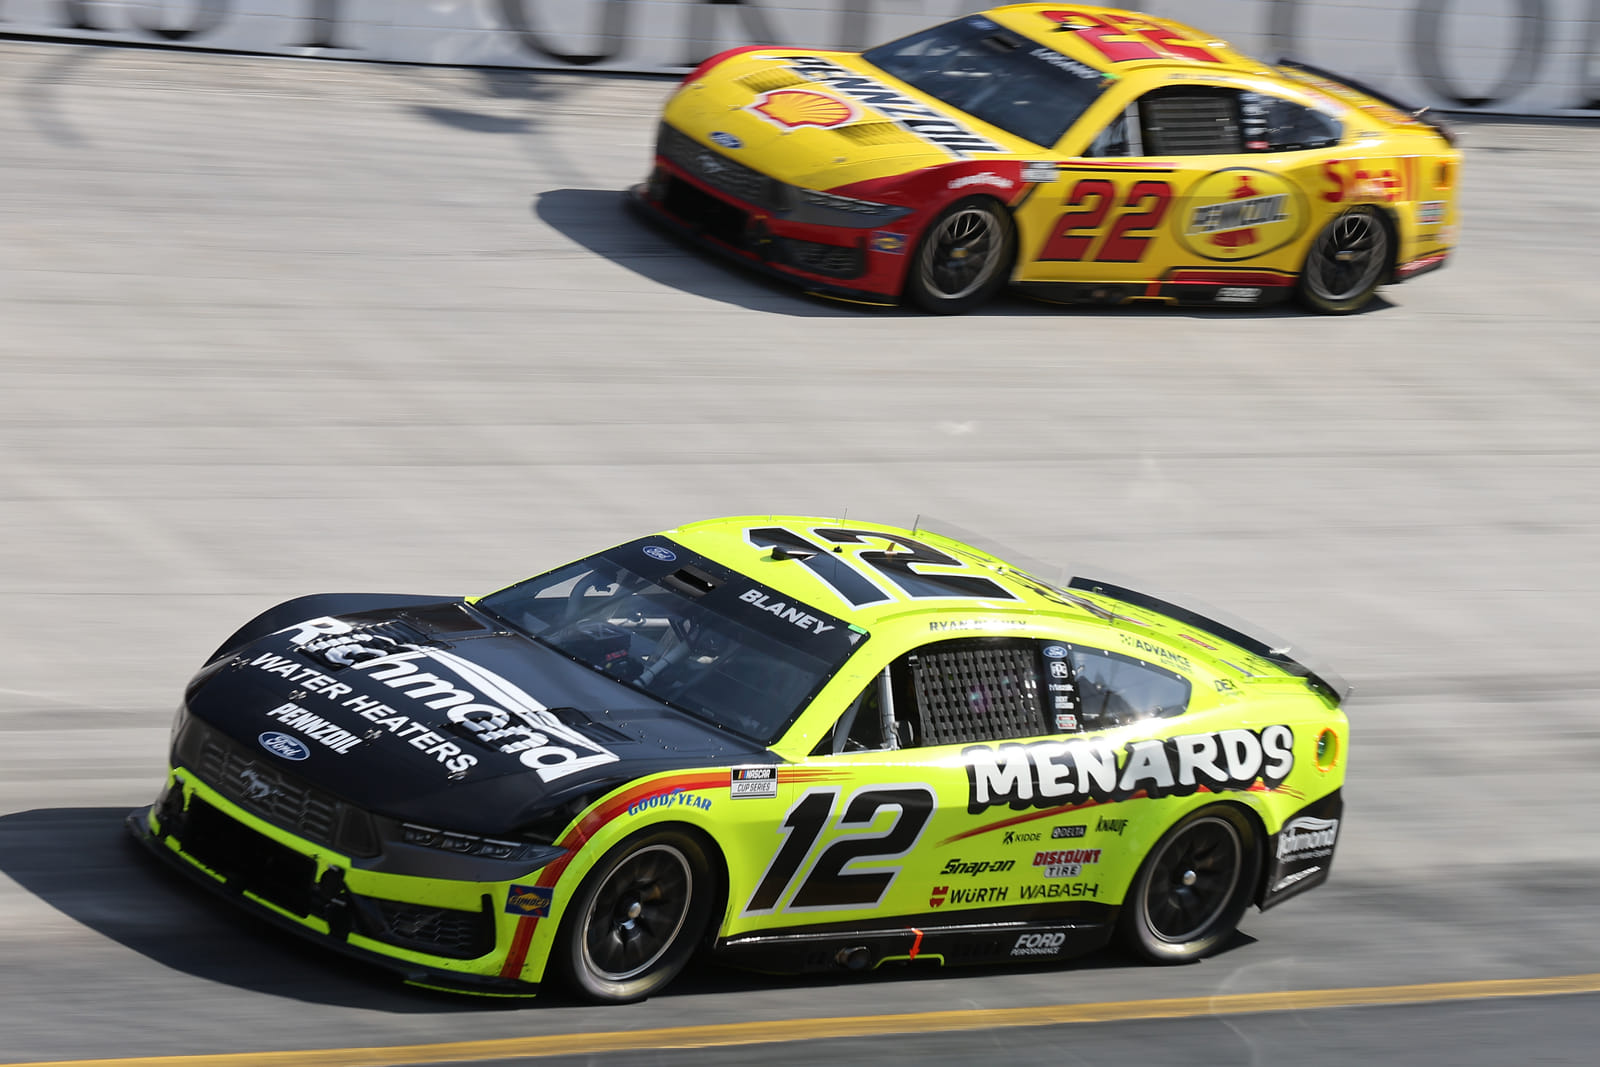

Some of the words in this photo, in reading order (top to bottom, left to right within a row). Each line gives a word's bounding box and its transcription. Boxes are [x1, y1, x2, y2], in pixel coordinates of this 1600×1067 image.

[1041, 10, 1226, 63] 22
[1037, 179, 1173, 263] 22
[742, 526, 1025, 611] 12
[738, 588, 836, 635] BLANEY
[1136, 639, 1191, 668] ADVANCE
[250, 652, 353, 701] WATER
[341, 694, 479, 772] HEATERS
[266, 615, 620, 784] Richmond
[266, 702, 363, 755] PENNZOIL
[264, 736, 302, 757] Ford
[747, 769, 771, 779] NASCAR
[967, 724, 1295, 808] MENARDS
[737, 784, 750, 792] CUP
[750, 783, 771, 791] SERIES
[627, 788, 713, 816] GOODYEAR
[1015, 833, 1042, 842] KIDDE
[1061, 826, 1085, 837] DELTA
[740, 783, 939, 918] 12
[1032, 848, 1102, 867] DISCOUNT
[940, 858, 1015, 877] Snap-on
[1048, 865, 1079, 876] TIRE
[1019, 883, 1098, 900] WABASH
[1014, 932, 1066, 949] FORD
